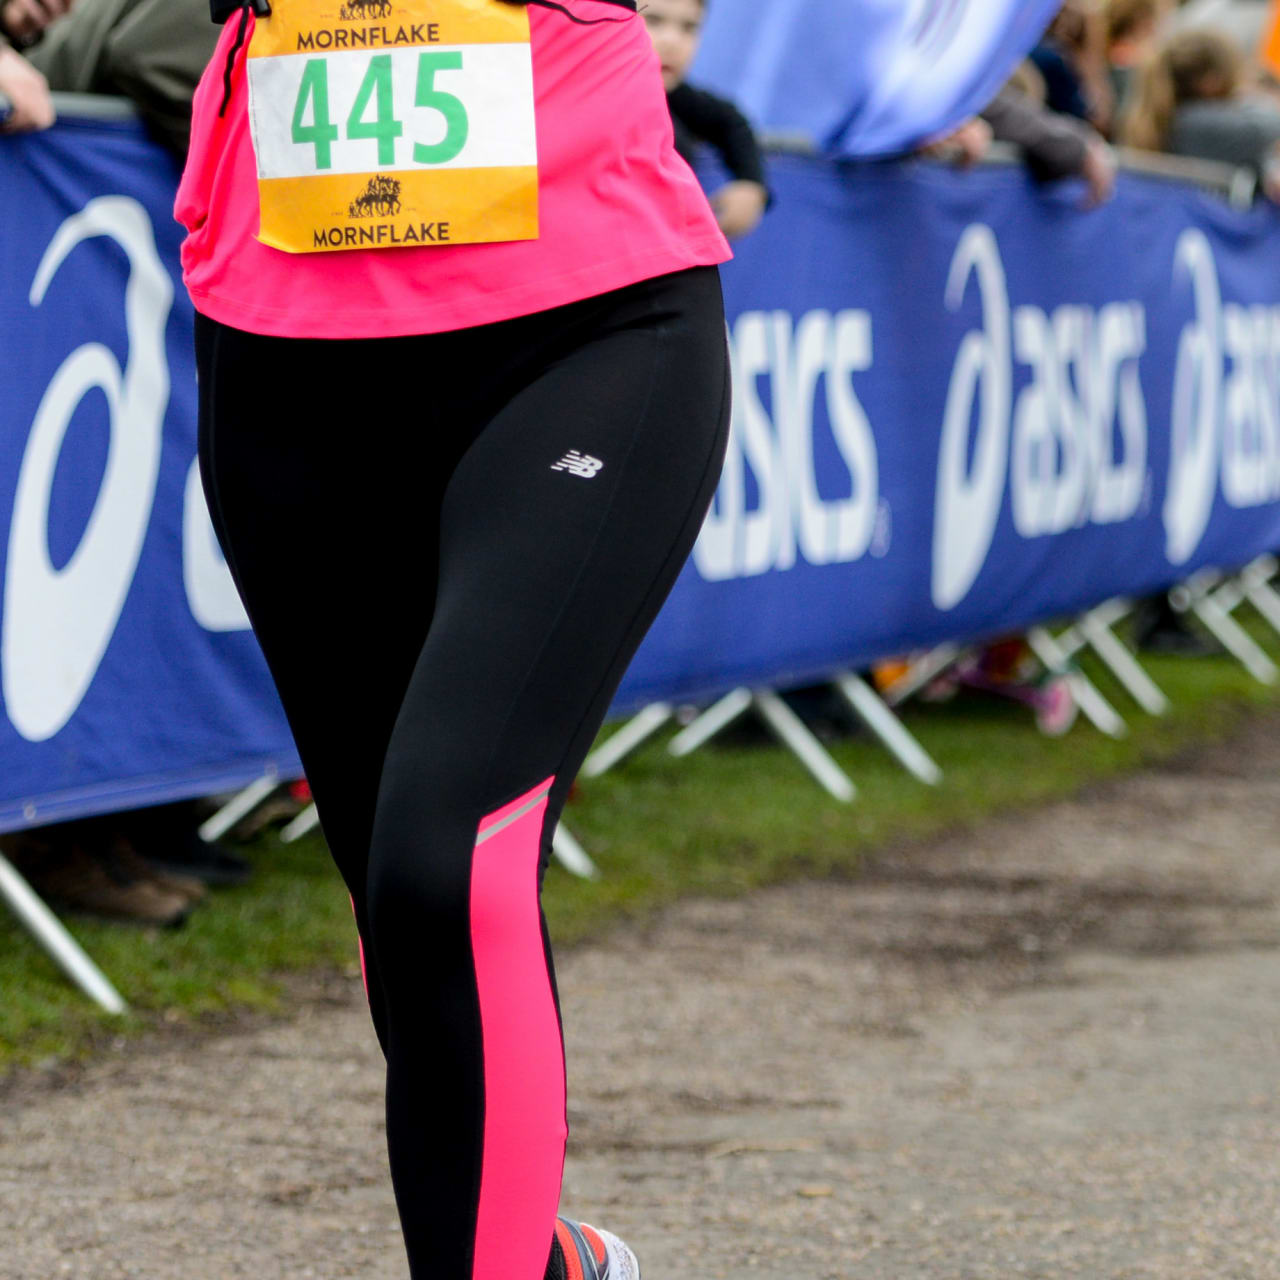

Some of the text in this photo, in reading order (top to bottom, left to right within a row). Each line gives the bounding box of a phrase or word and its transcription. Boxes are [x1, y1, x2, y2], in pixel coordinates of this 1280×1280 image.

[296, 23, 440, 51] MORNFLAKE
[291, 51, 469, 170] 445
[313, 222, 451, 249] MORNFLAKE
